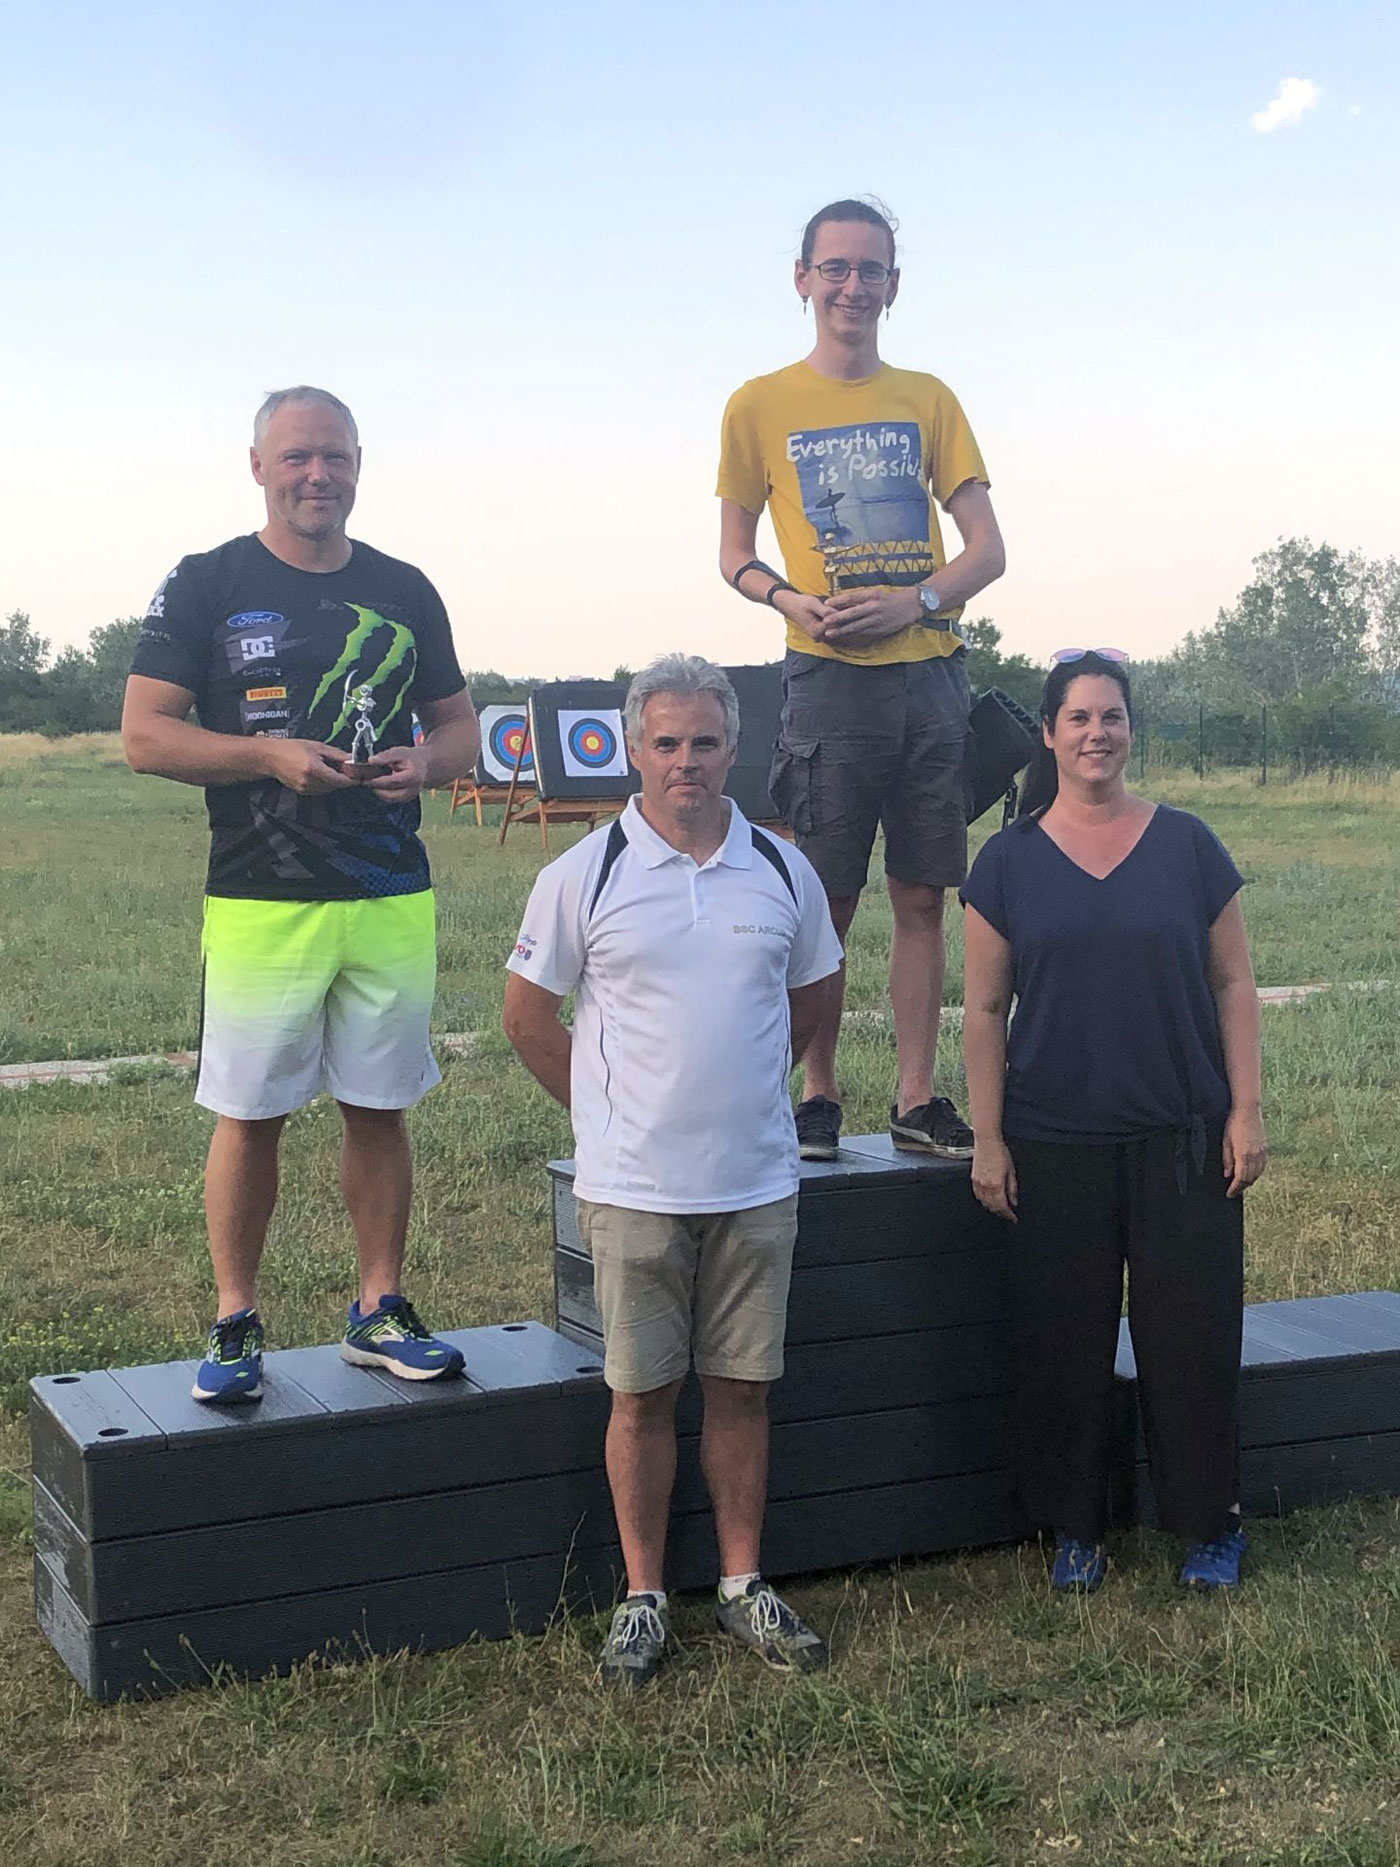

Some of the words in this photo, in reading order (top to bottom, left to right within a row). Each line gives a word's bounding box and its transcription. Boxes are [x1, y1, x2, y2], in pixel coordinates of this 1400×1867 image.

[786, 427, 910, 462] Everything
[818, 464, 839, 485] is
[237, 613, 273, 626] Ford
